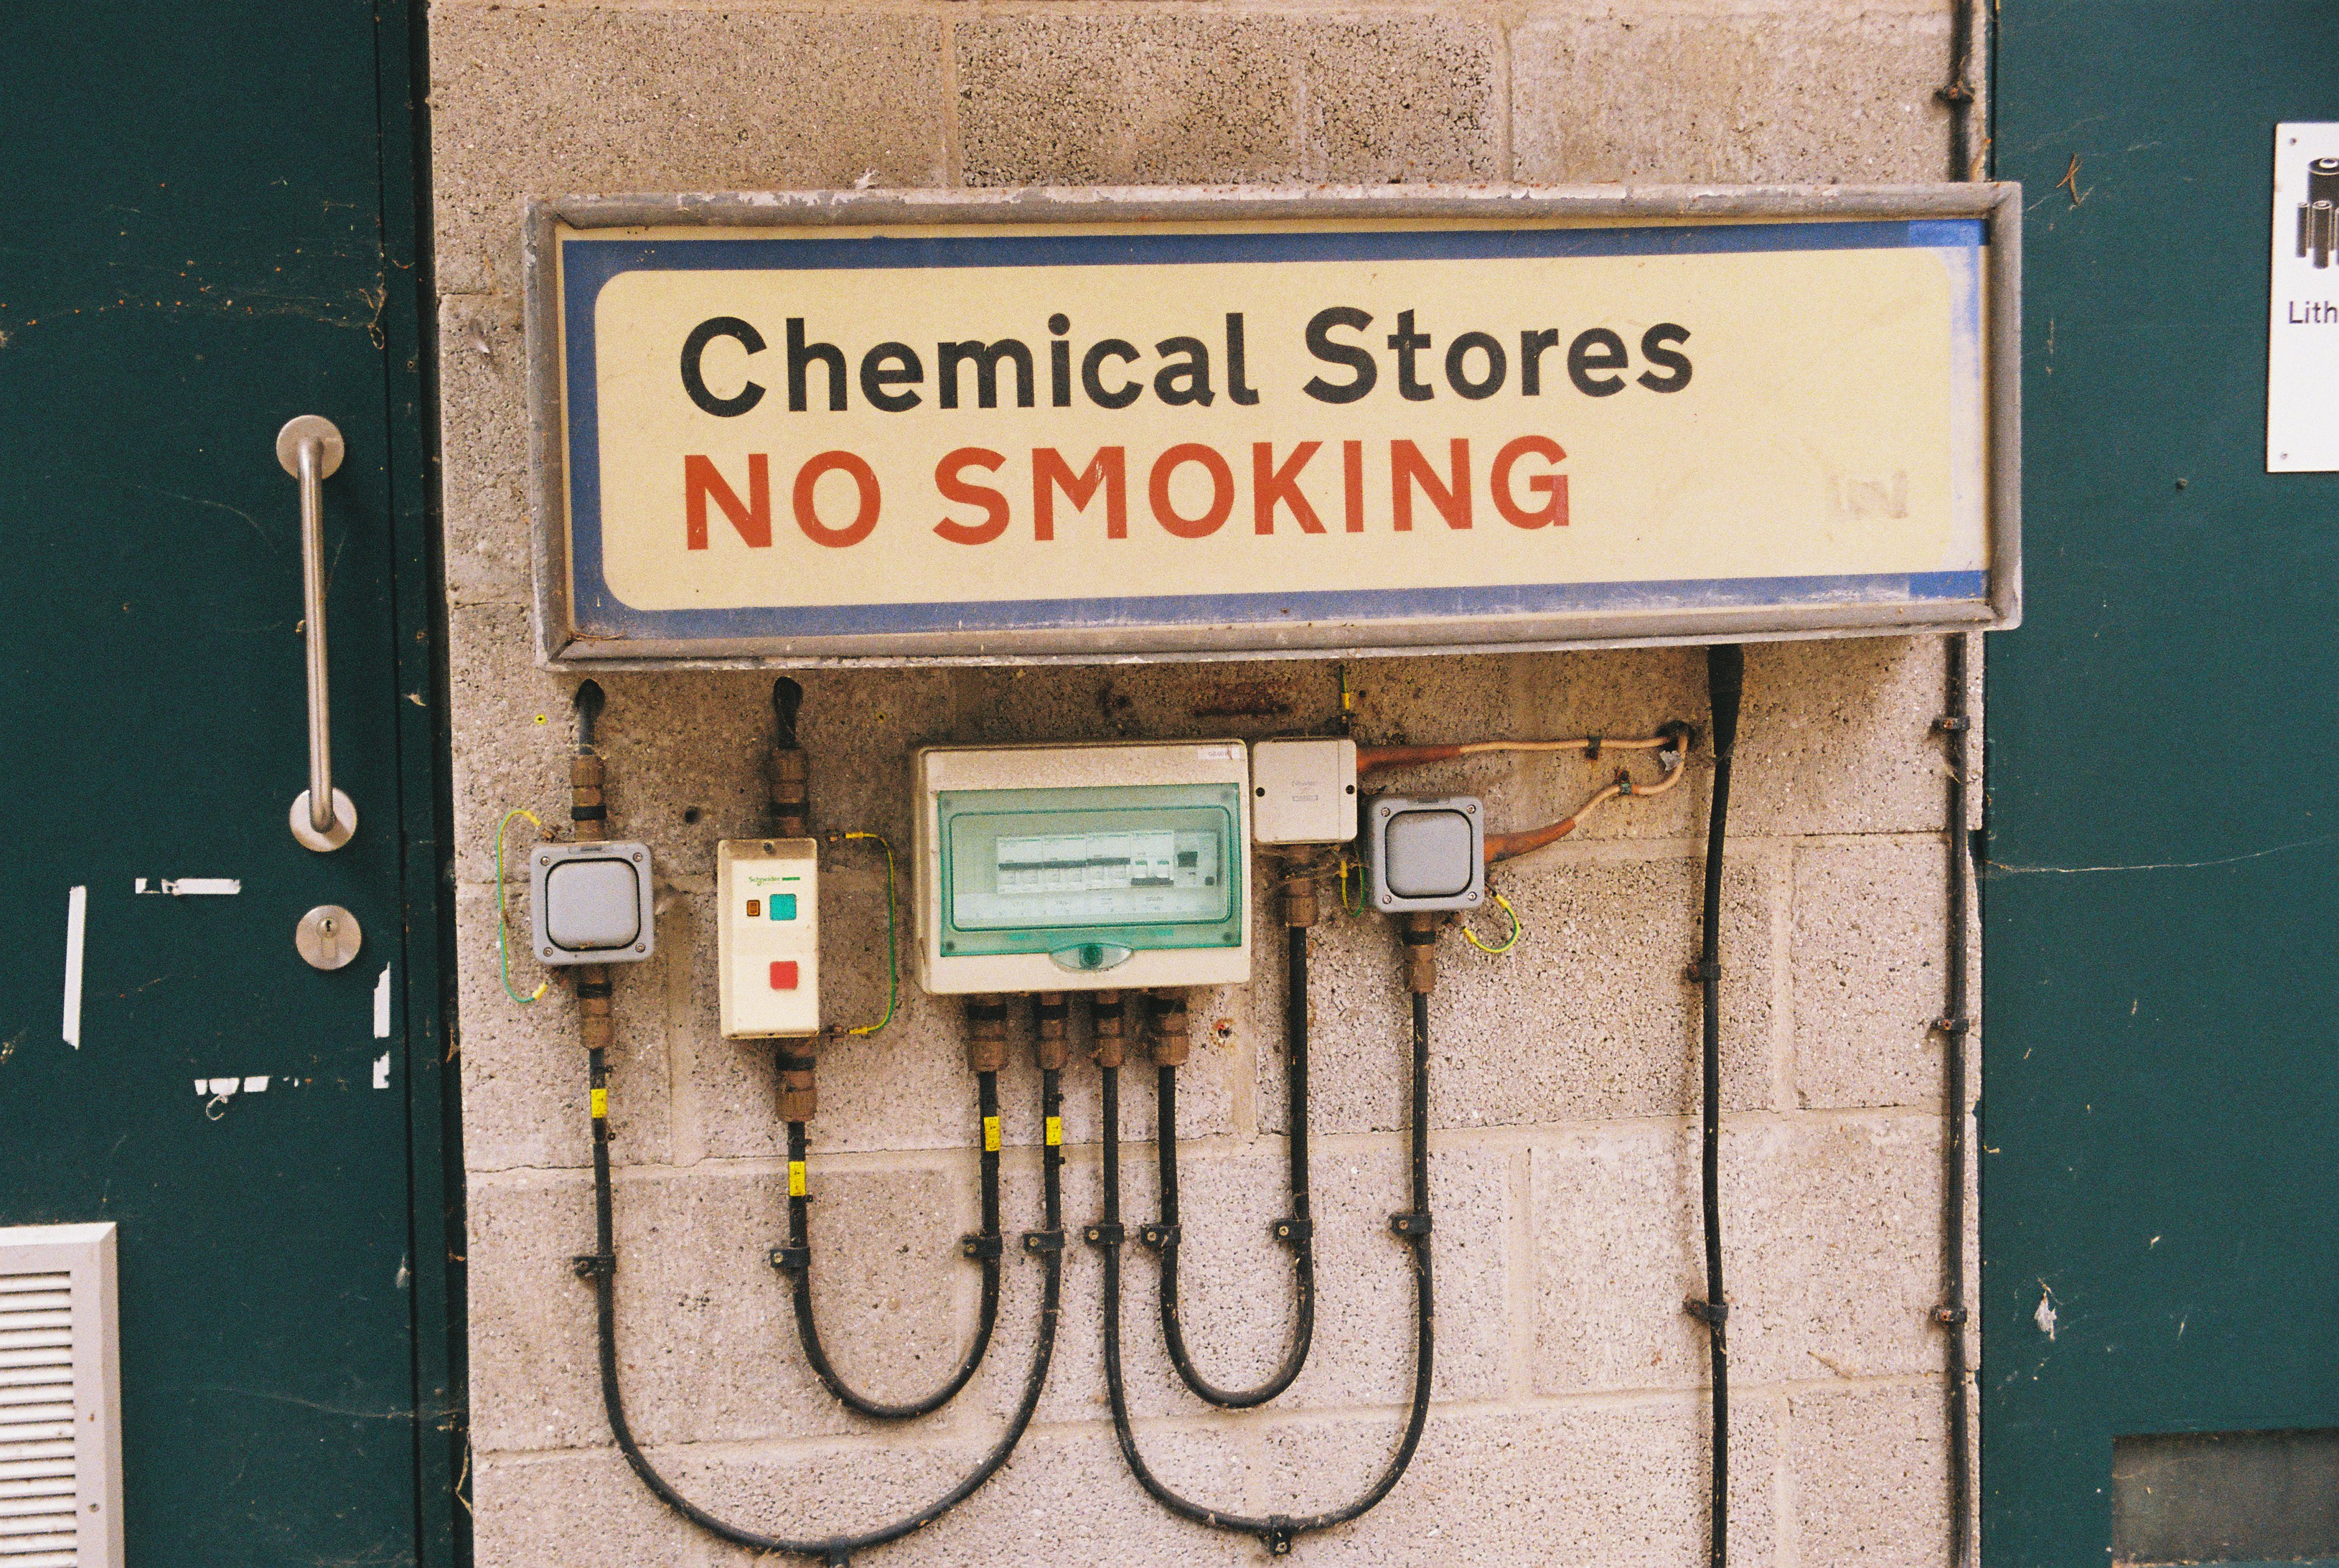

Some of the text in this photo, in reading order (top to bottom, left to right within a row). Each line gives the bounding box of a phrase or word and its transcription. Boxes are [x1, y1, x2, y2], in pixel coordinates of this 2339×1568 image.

[2289, 300, 2338, 324] Lith
[680, 306, 1692, 418] Chemical Stores
[684, 434, 1570, 552] NO SMOKING
[749, 876, 780, 886] Schneider
